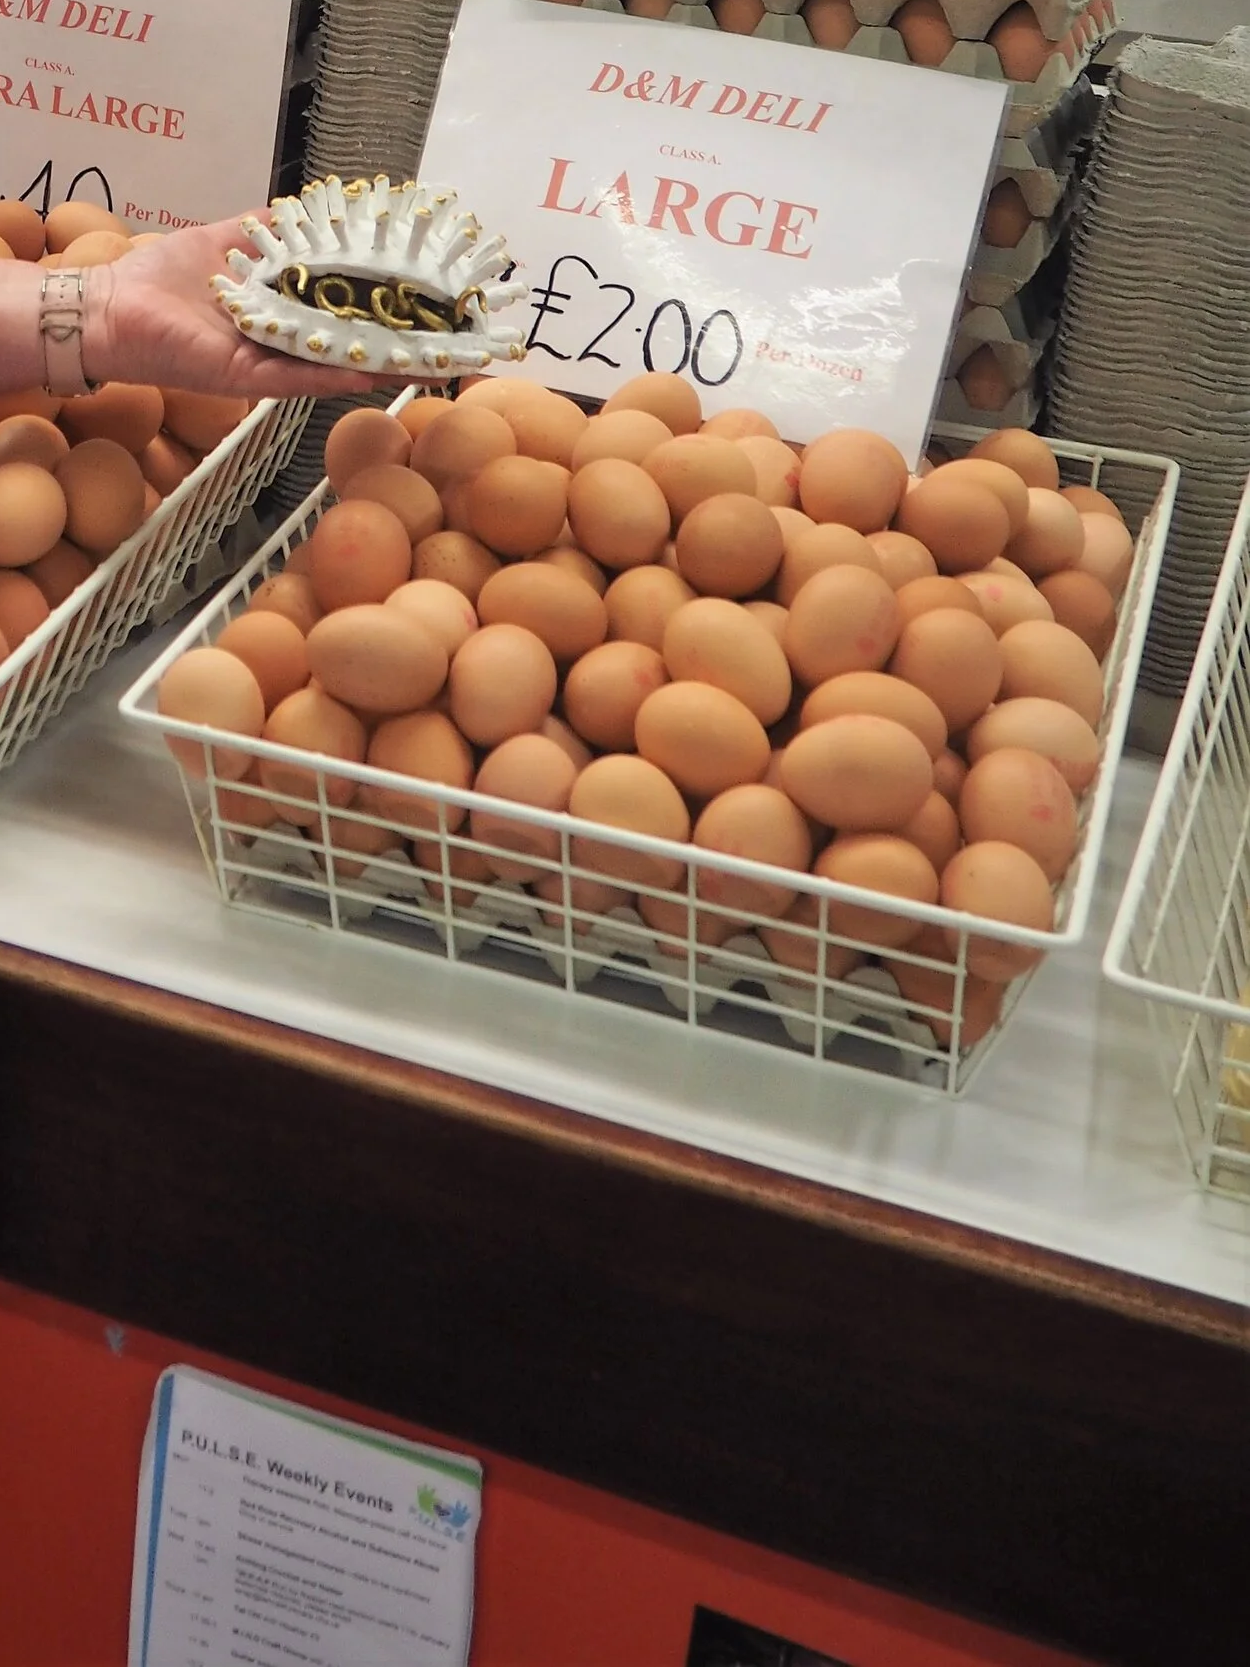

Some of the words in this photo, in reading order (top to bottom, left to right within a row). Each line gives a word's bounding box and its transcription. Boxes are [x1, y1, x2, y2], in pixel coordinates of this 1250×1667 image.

[59, 0, 156, 45] DELI
[24, 56, 60, 74] CLASS
[50, 84, 187, 141] LARGE
[587, 62, 707, 109] D&M
[709, 83, 834, 134] DELI
[659, 144, 703, 164] CLASS
[124, 202, 154, 223] Per
[537, 157, 819, 260] LARGE
[267, 1460, 330, 1495] Weekly
[334, 1481, 394, 1513] Events
